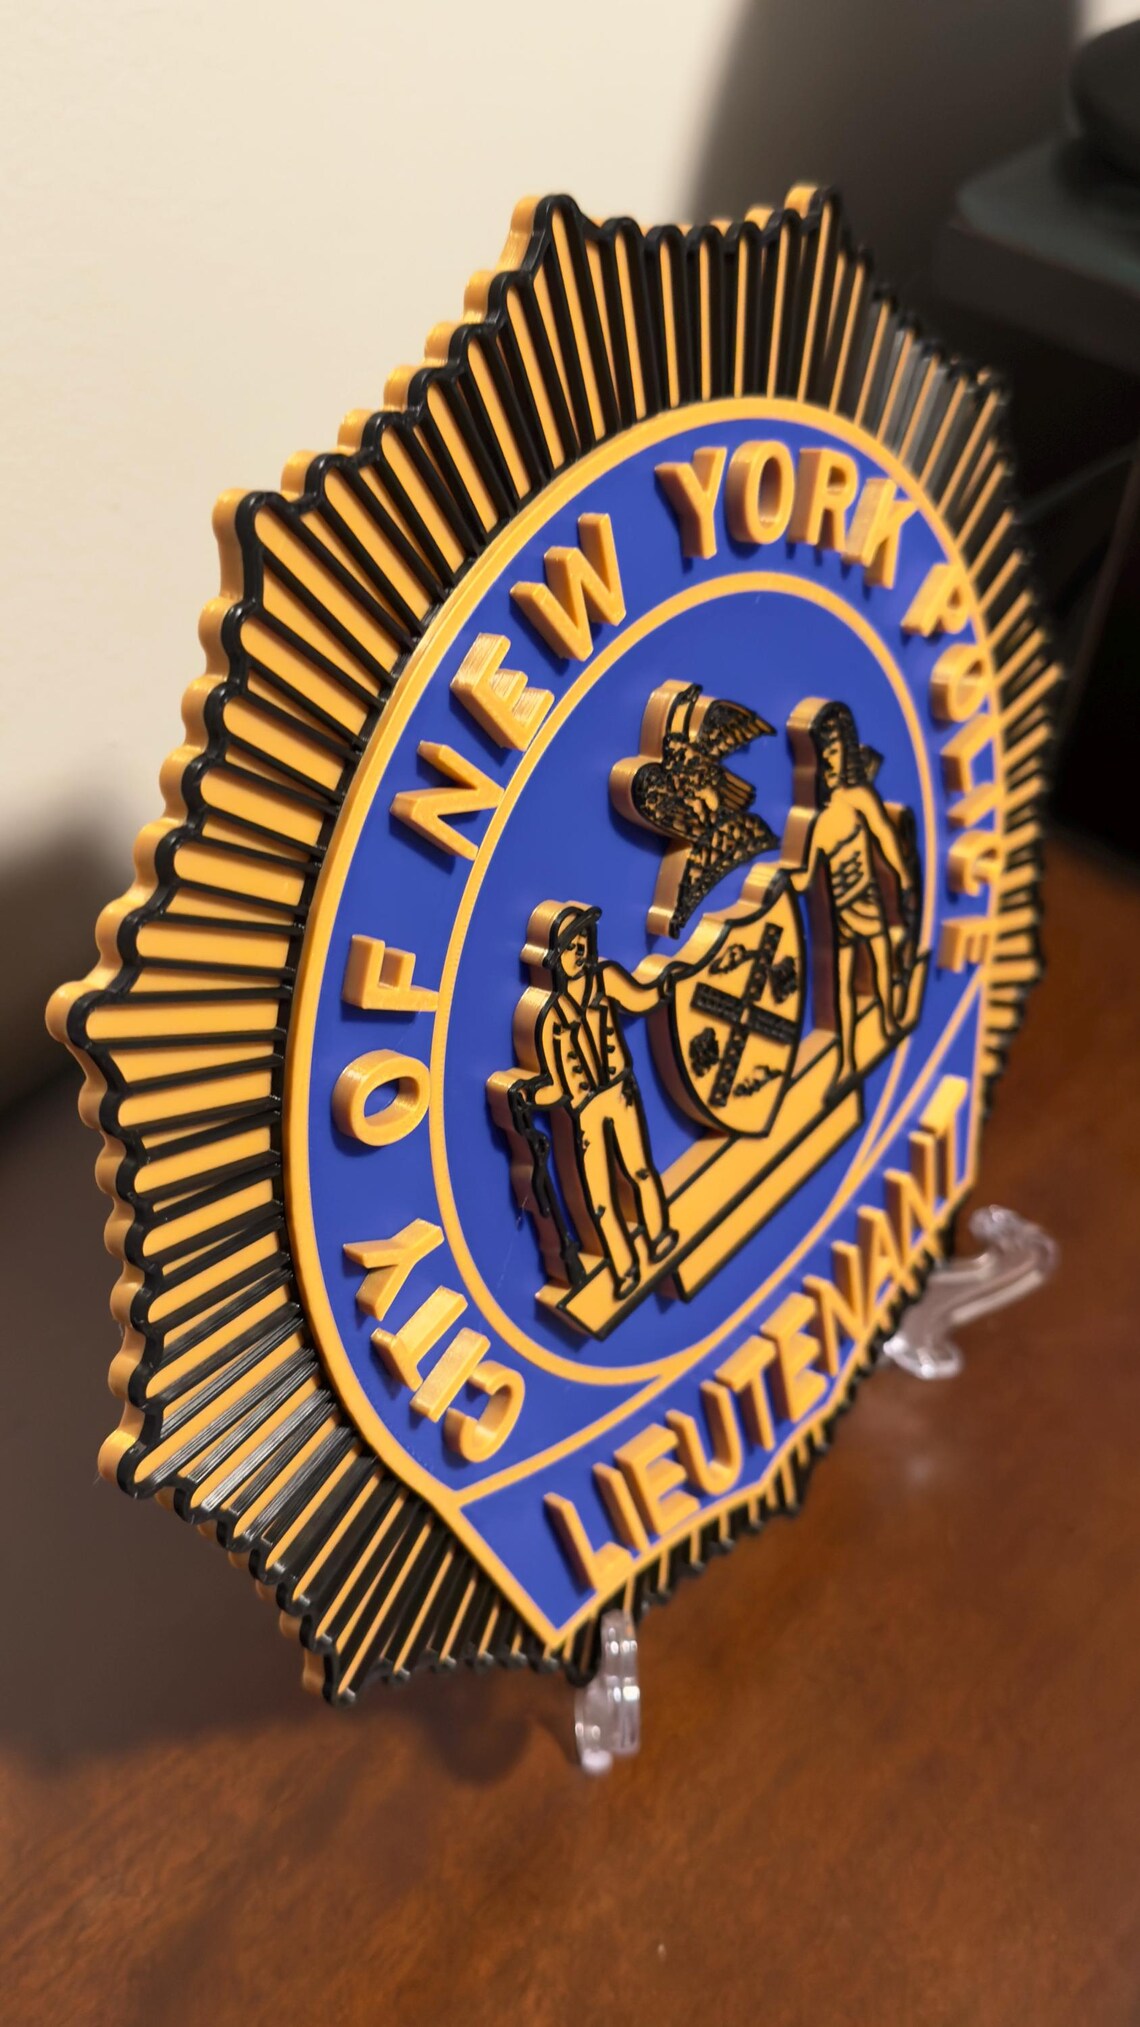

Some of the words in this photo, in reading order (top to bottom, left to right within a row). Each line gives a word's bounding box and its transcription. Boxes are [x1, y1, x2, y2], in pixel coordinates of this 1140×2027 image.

[655, 440, 918, 589] YORK
[389, 513, 626, 861] NEW
[902, 563, 1002, 972] POLICE
[332, 934, 439, 1146] OF
[343, 1218, 525, 1462] CITY
[544, 1076, 968, 1591] LIEUTENANT
